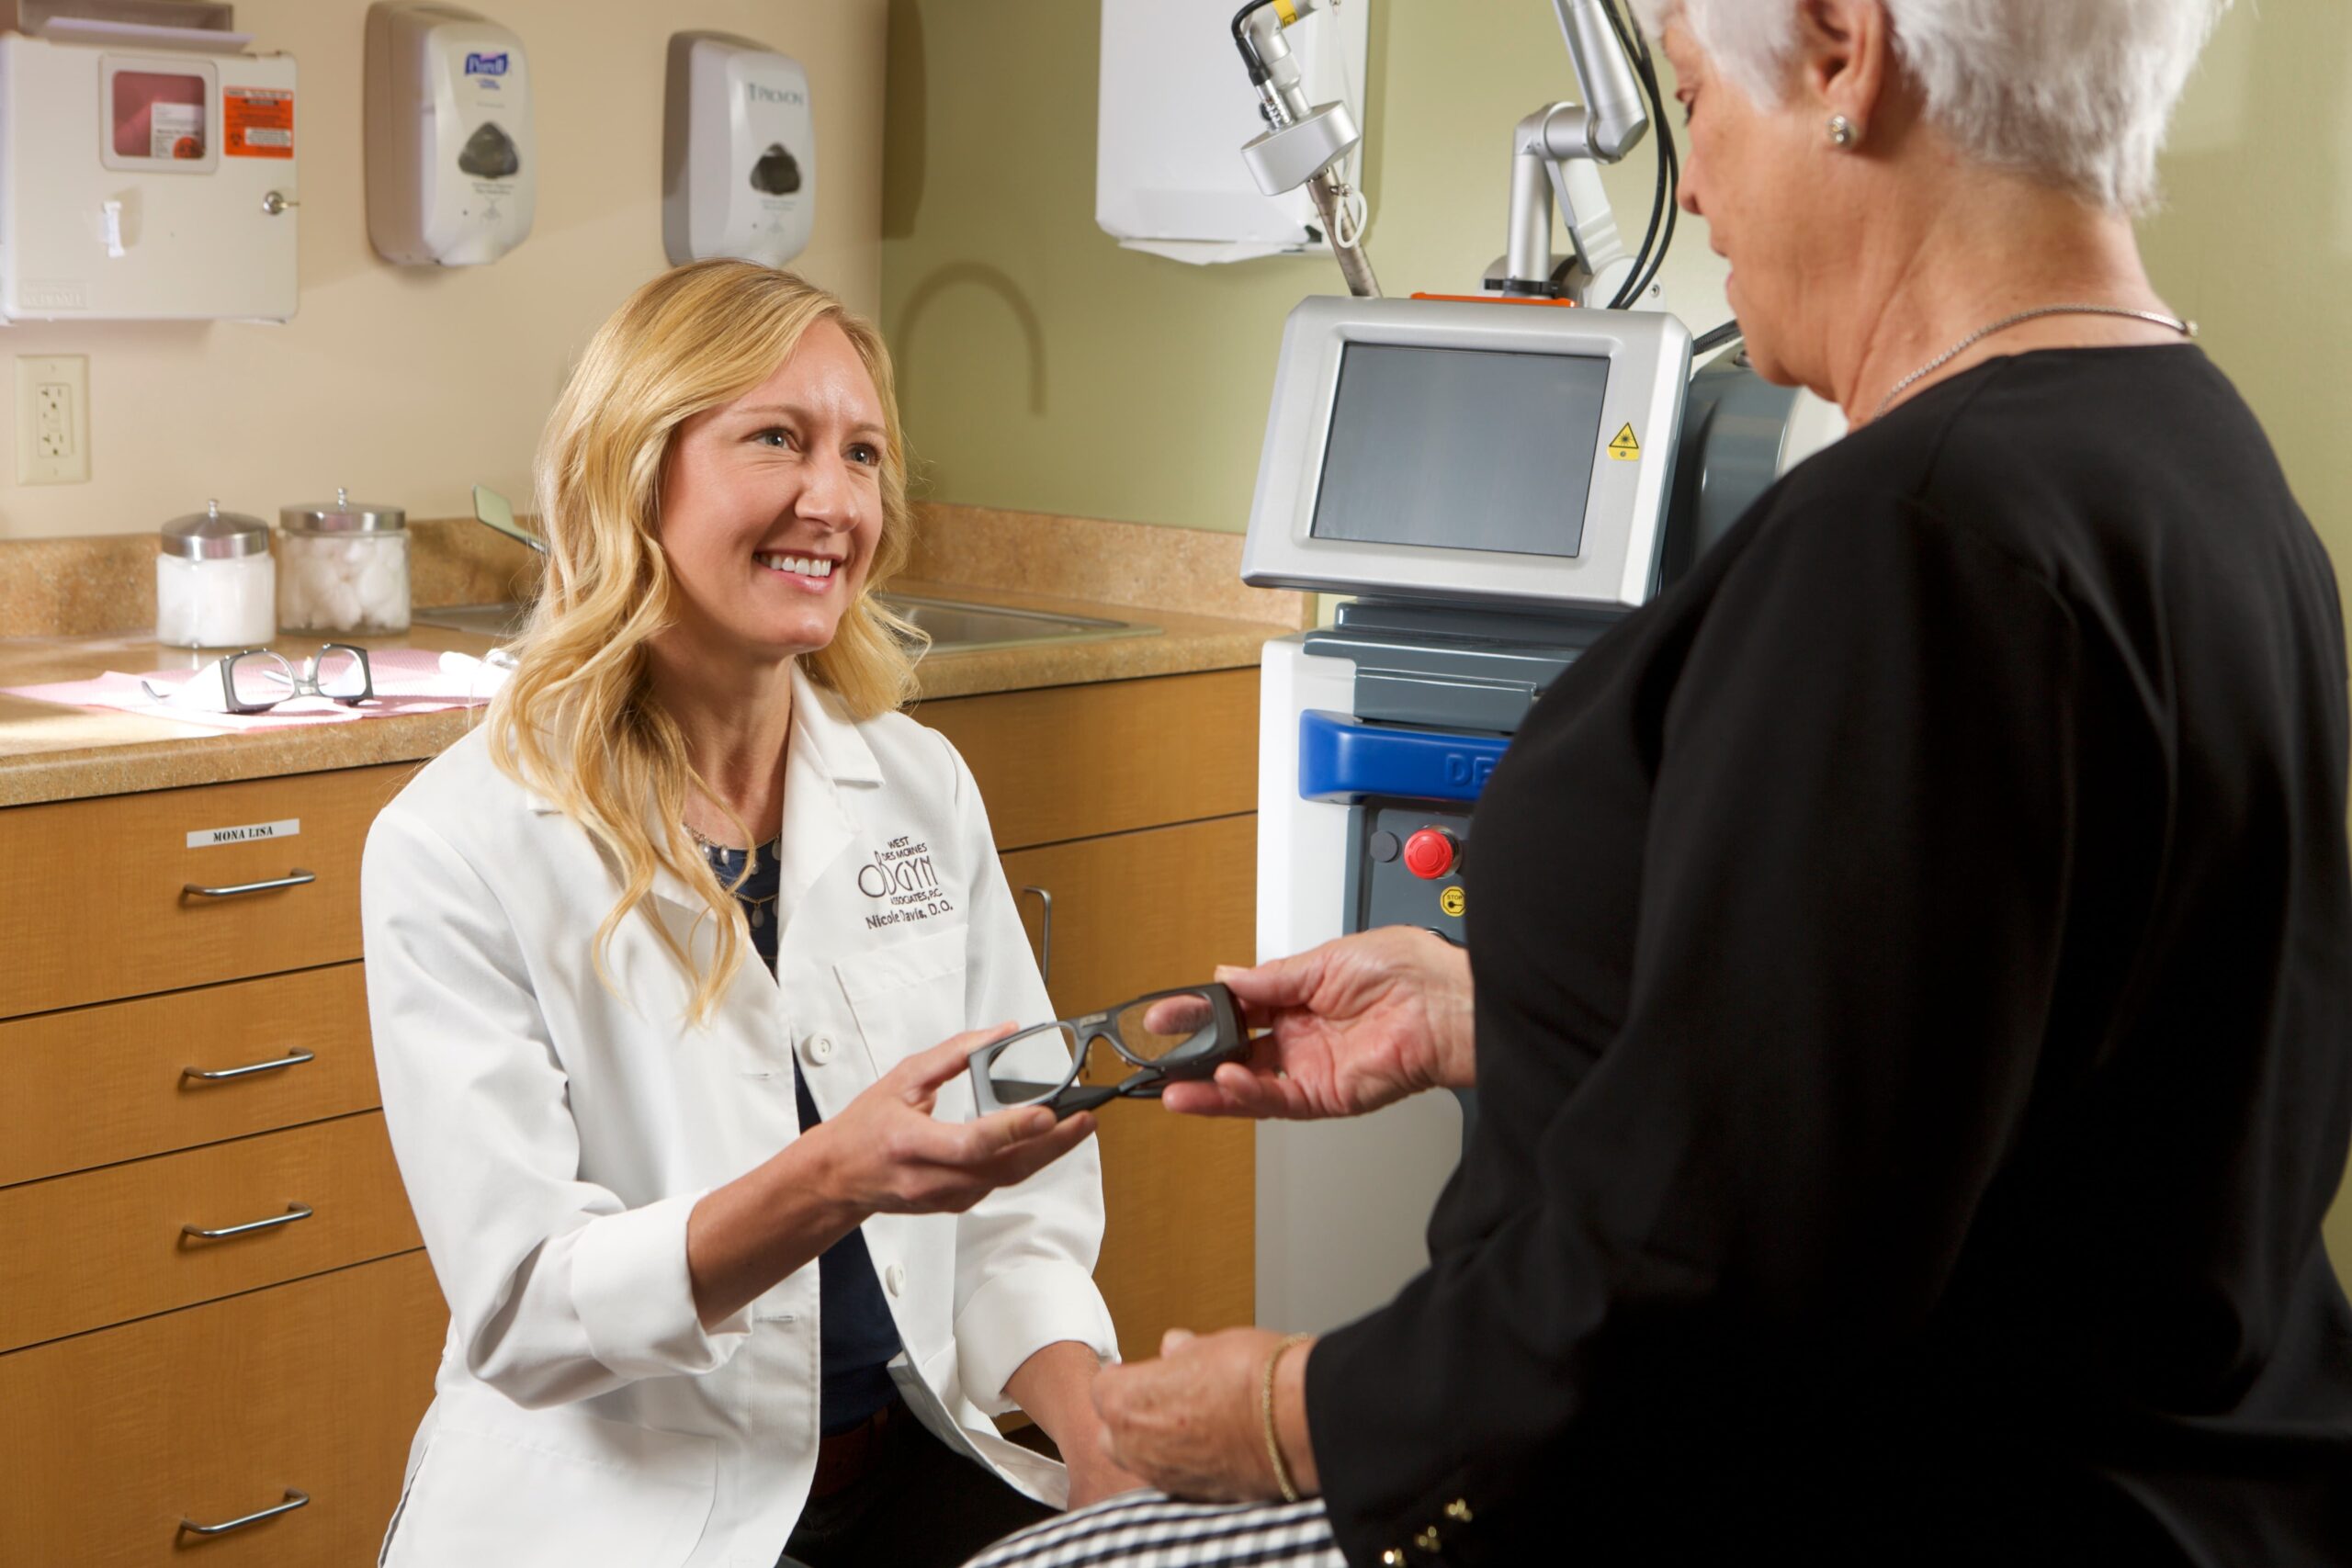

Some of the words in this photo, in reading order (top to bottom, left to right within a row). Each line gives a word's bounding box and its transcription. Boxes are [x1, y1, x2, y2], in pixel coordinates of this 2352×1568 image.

[213, 829, 245, 842] MONA
[249, 826, 274, 838] LISA
[888, 836, 910, 849] WEST
[896, 842, 928, 858] MOINES
[865, 910, 900, 930] Nicole
[928, 899, 954, 916] D.O.
